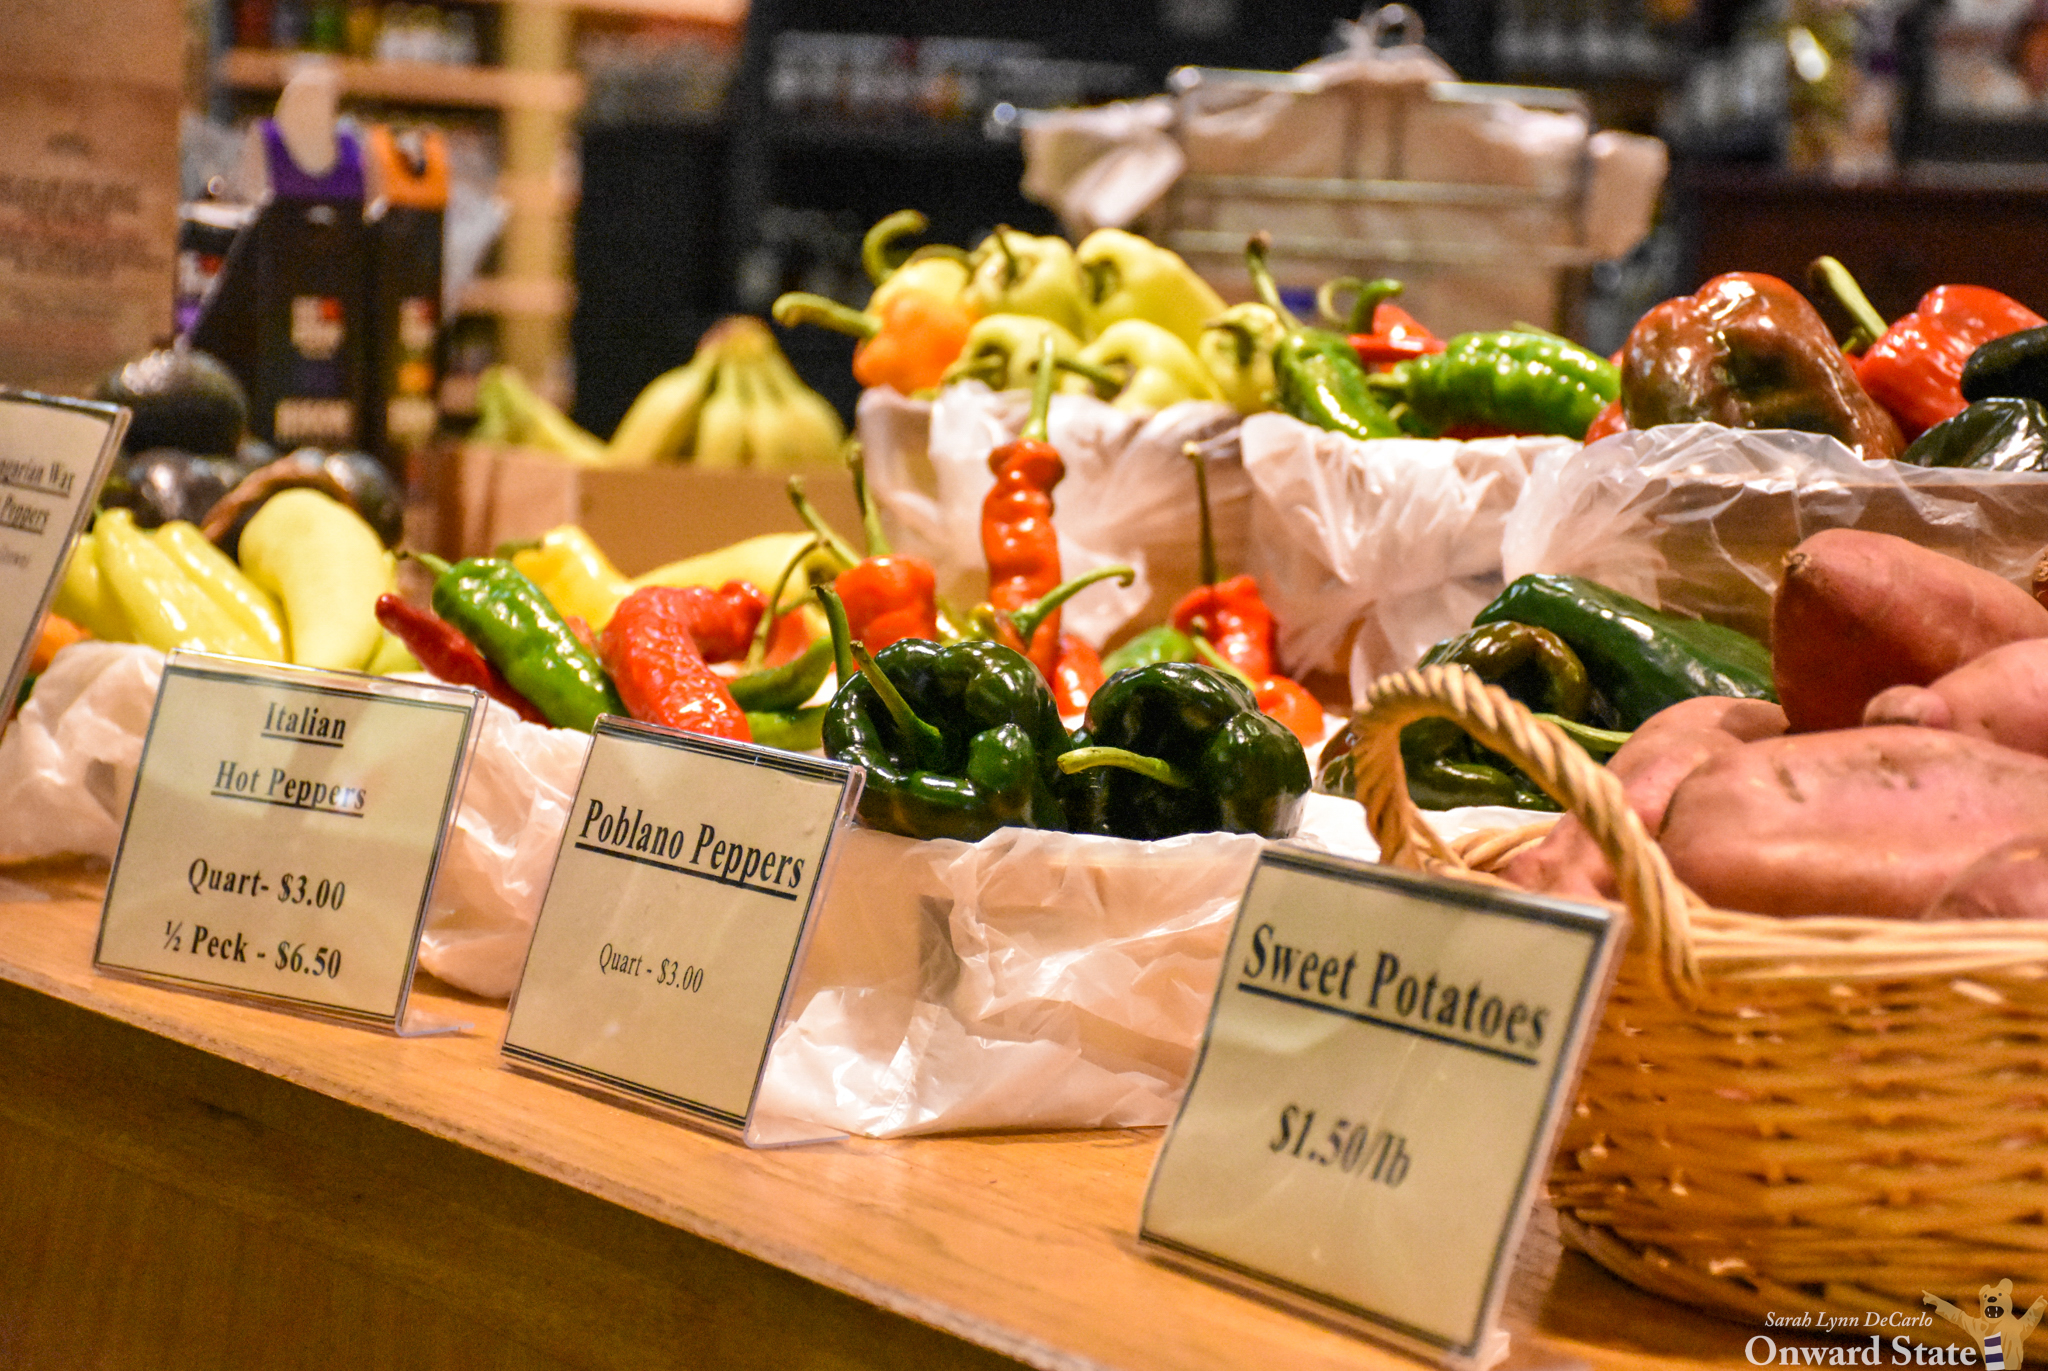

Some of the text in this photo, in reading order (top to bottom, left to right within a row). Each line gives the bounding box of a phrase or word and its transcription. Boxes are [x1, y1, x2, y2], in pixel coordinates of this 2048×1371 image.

[263, 702, 346, 740] Italian
[214, 760, 367, 810] Hot Peppers
[578, 798, 806, 889] Poblano Peppers
[188, 857, 345, 911] Quart- $3.00
[190, 924, 249, 963] Peck
[274, 940, 342, 979] $6.50
[599, 943, 643, 977] Quart
[656, 957, 704, 993] $3.00
[1243, 923, 1551, 1049] Sweet Potatoes
